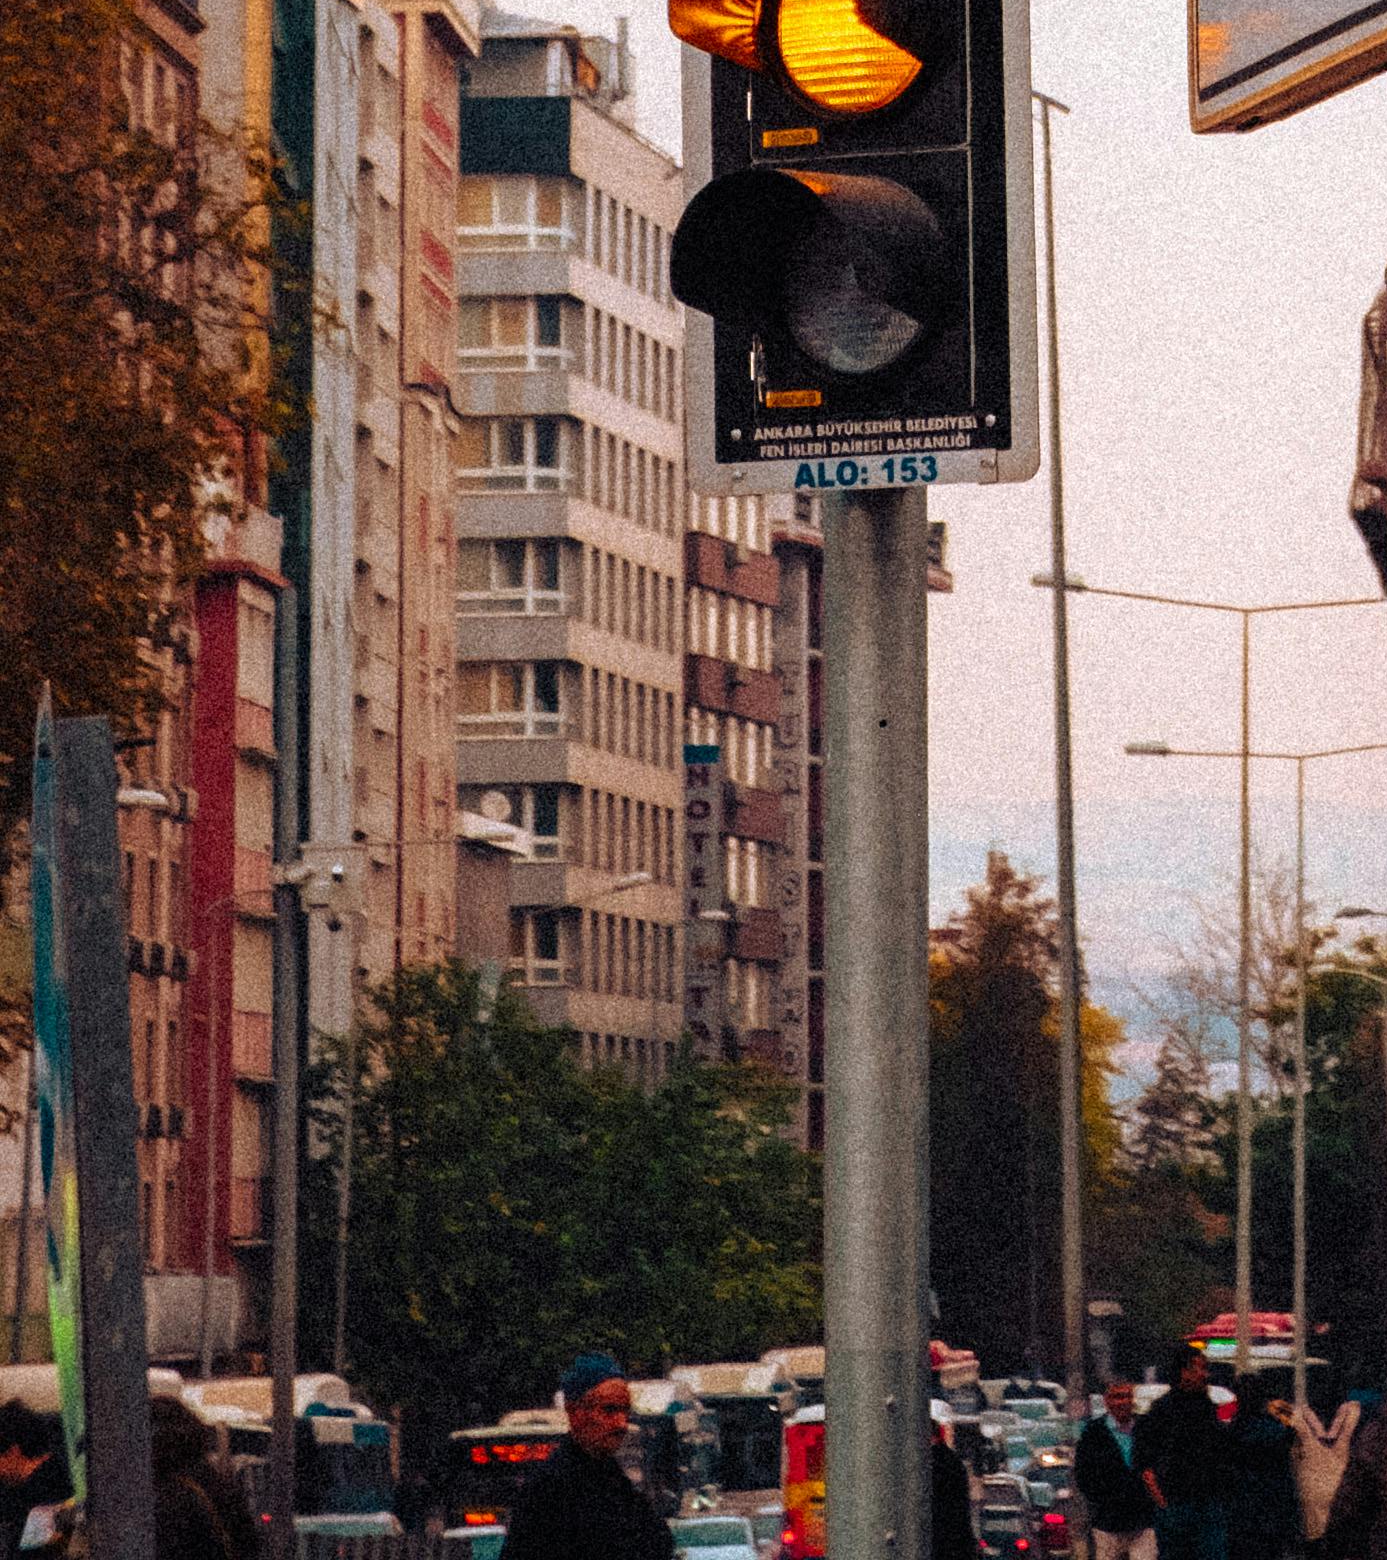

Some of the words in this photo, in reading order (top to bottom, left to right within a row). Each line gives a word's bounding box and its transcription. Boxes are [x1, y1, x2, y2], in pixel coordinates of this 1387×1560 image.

[754, 425, 813, 441] ANKARA
[760, 443, 785, 458] FEN
[794, 459, 869, 489] ALO:
[881, 454, 939, 484] 153
